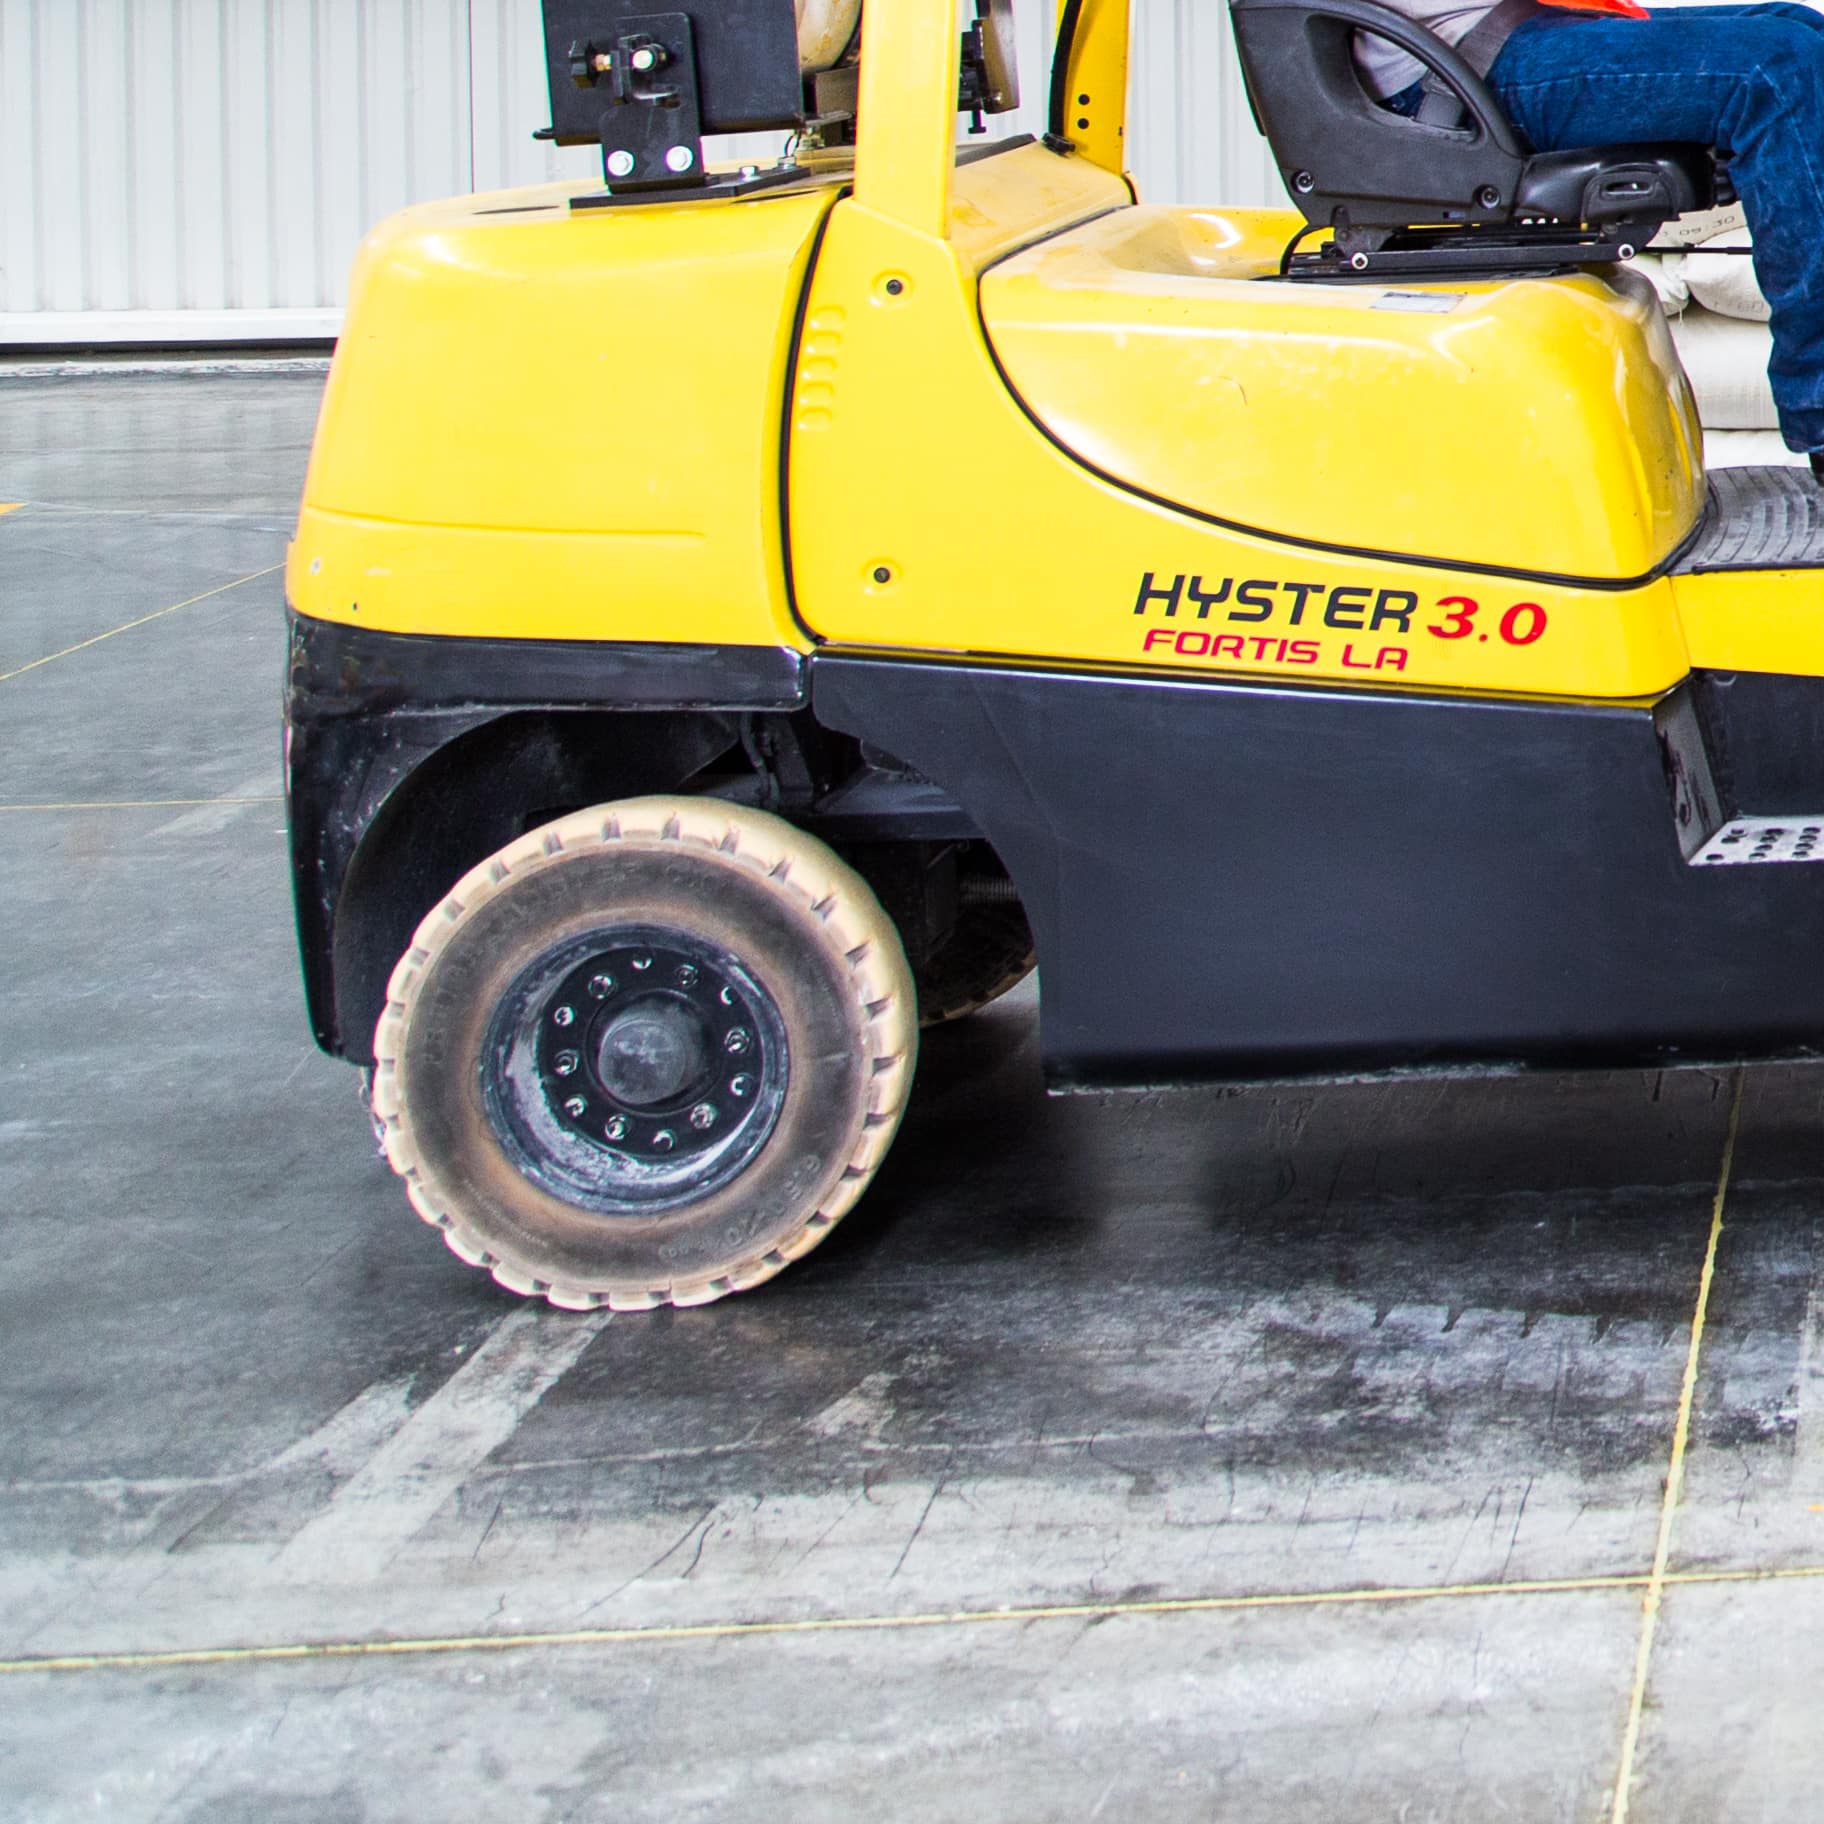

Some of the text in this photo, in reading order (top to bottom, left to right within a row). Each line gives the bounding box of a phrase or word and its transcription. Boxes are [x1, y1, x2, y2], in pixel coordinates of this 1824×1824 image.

[1132, 571, 1549, 647] HYSTER 3.0
[1141, 628, 1410, 672] FORTIS LA
